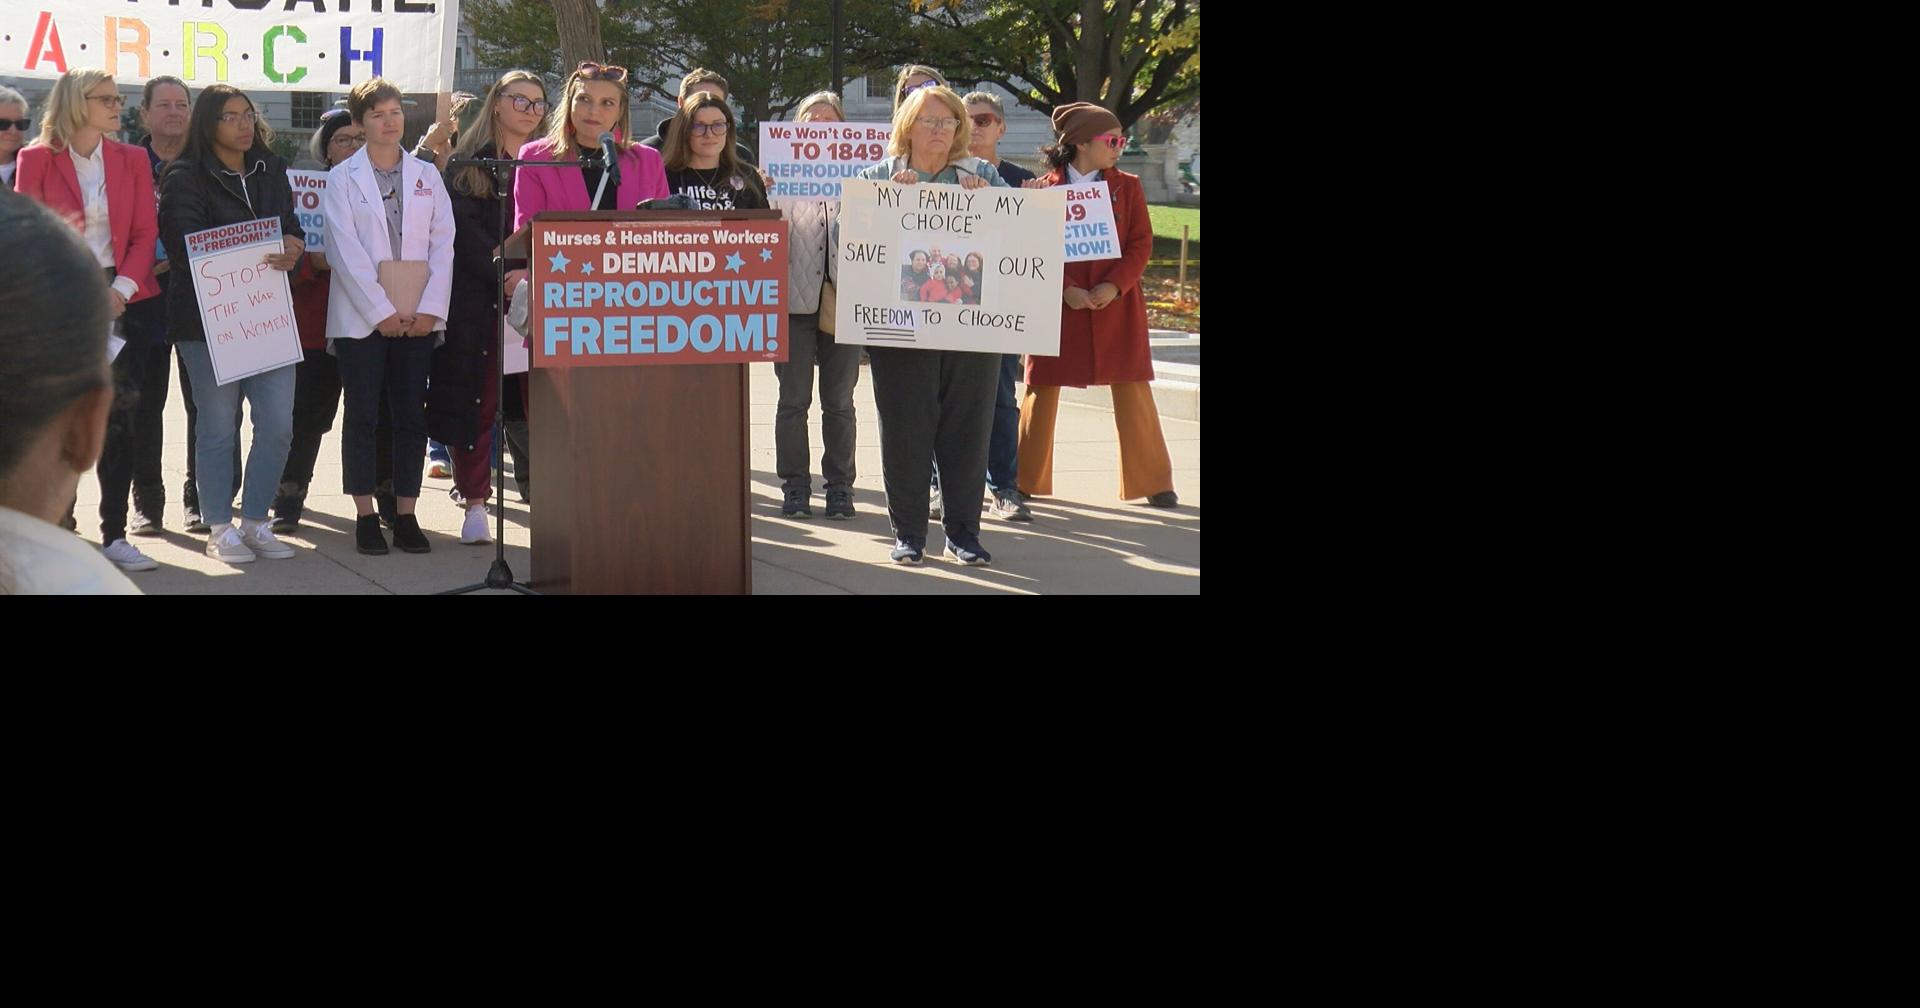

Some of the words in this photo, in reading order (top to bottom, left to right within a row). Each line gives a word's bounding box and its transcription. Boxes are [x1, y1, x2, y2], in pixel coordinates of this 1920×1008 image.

[768, 127, 791, 139] We
[795, 127, 838, 139] Won't
[842, 128, 862, 140] Go
[866, 128, 892, 140] Bac
[791, 142, 820, 160] TO
[826, 143, 883, 161] 1849
[768, 163, 869, 178] REPRODUC
[918, 189, 975, 212] FAMILY
[995, 196, 1024, 216] MY
[1066, 187, 1101, 201] Back
[188, 219, 278, 247] REPRODUCTIVE
[204, 231, 264, 253] FREEDOM!
[543, 230, 601, 246] Nurses
[605, 231, 617, 245] &
[620, 230, 709, 245] Healthcare
[713, 229, 779, 245] Workers
[1064, 240, 1112, 257] NOW!
[602, 251, 716, 274] DEMAND
[845, 242, 887, 264] SAVE
[999, 256, 1046, 281] OUR
[200, 260, 270, 297] STOP
[543, 279, 779, 309] REPRODUCTIVE
[207, 302, 240, 322] THE
[854, 304, 914, 327] FREEDOM
[922, 309, 942, 325] TO
[958, 309, 1026, 332] CHOOSE
[543, 313, 779, 356] FREEDOM!
